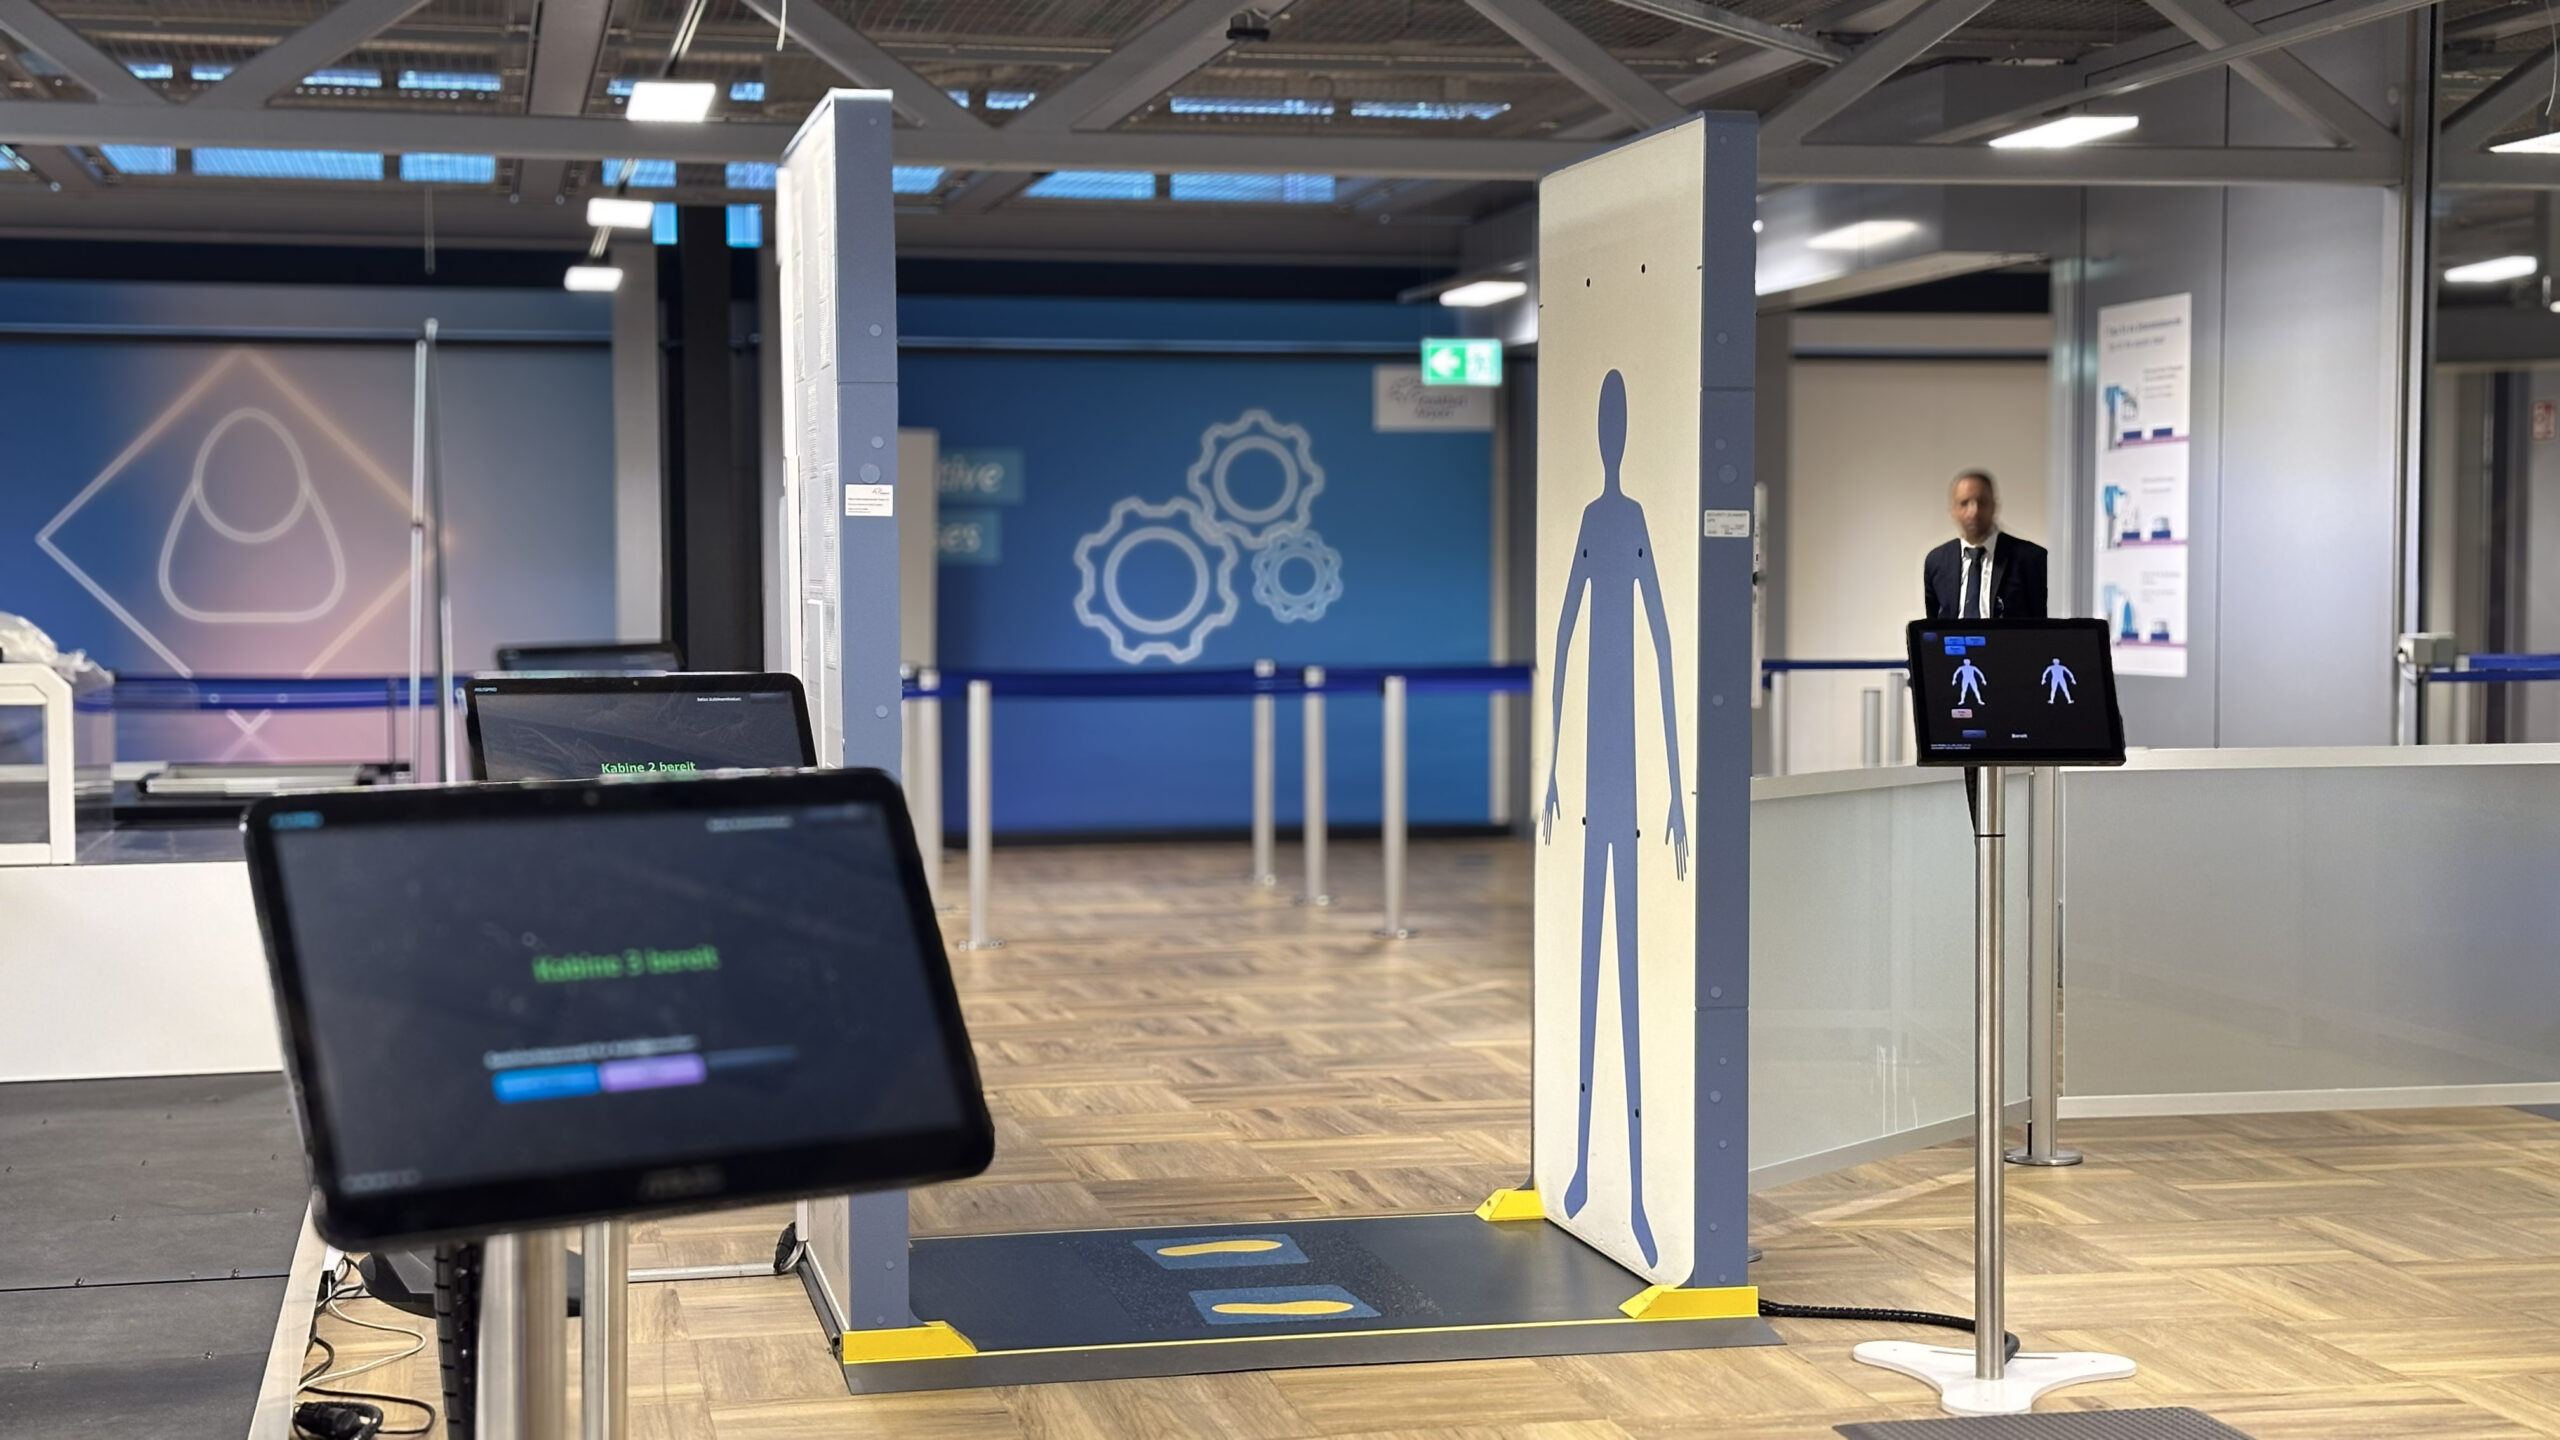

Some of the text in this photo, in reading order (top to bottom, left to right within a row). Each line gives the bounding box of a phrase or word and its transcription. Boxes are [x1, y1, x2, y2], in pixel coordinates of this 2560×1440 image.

[601, 761, 696, 774] Kabine 2 bereit
[533, 944, 721, 983] Kabine 3 bereit
